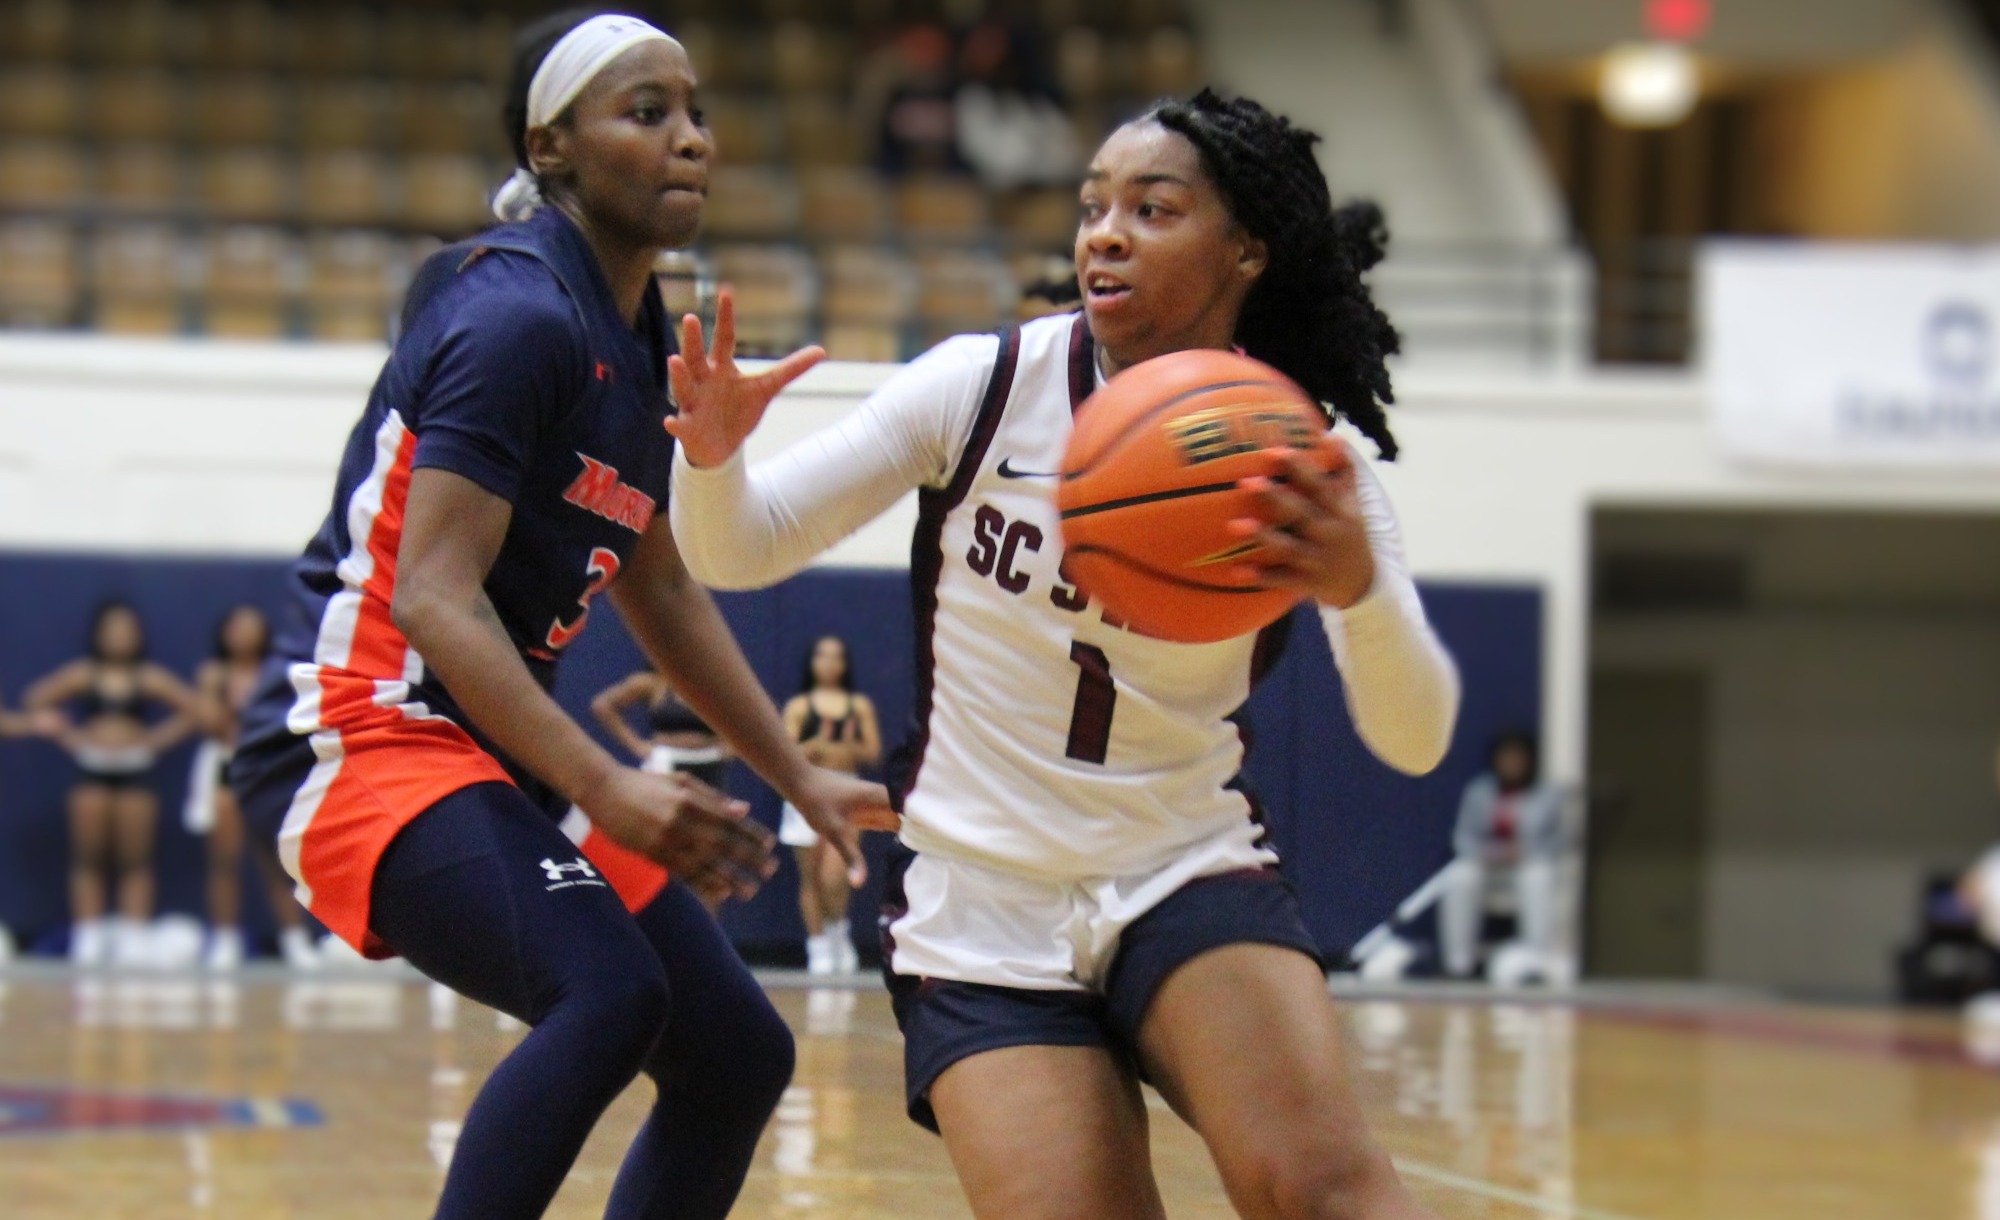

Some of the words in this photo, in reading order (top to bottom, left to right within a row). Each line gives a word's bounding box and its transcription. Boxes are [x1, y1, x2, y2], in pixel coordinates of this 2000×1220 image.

[546, 547, 620, 650] 3
[966, 504, 1043, 595] SC
[1065, 639, 1117, 766] 1
